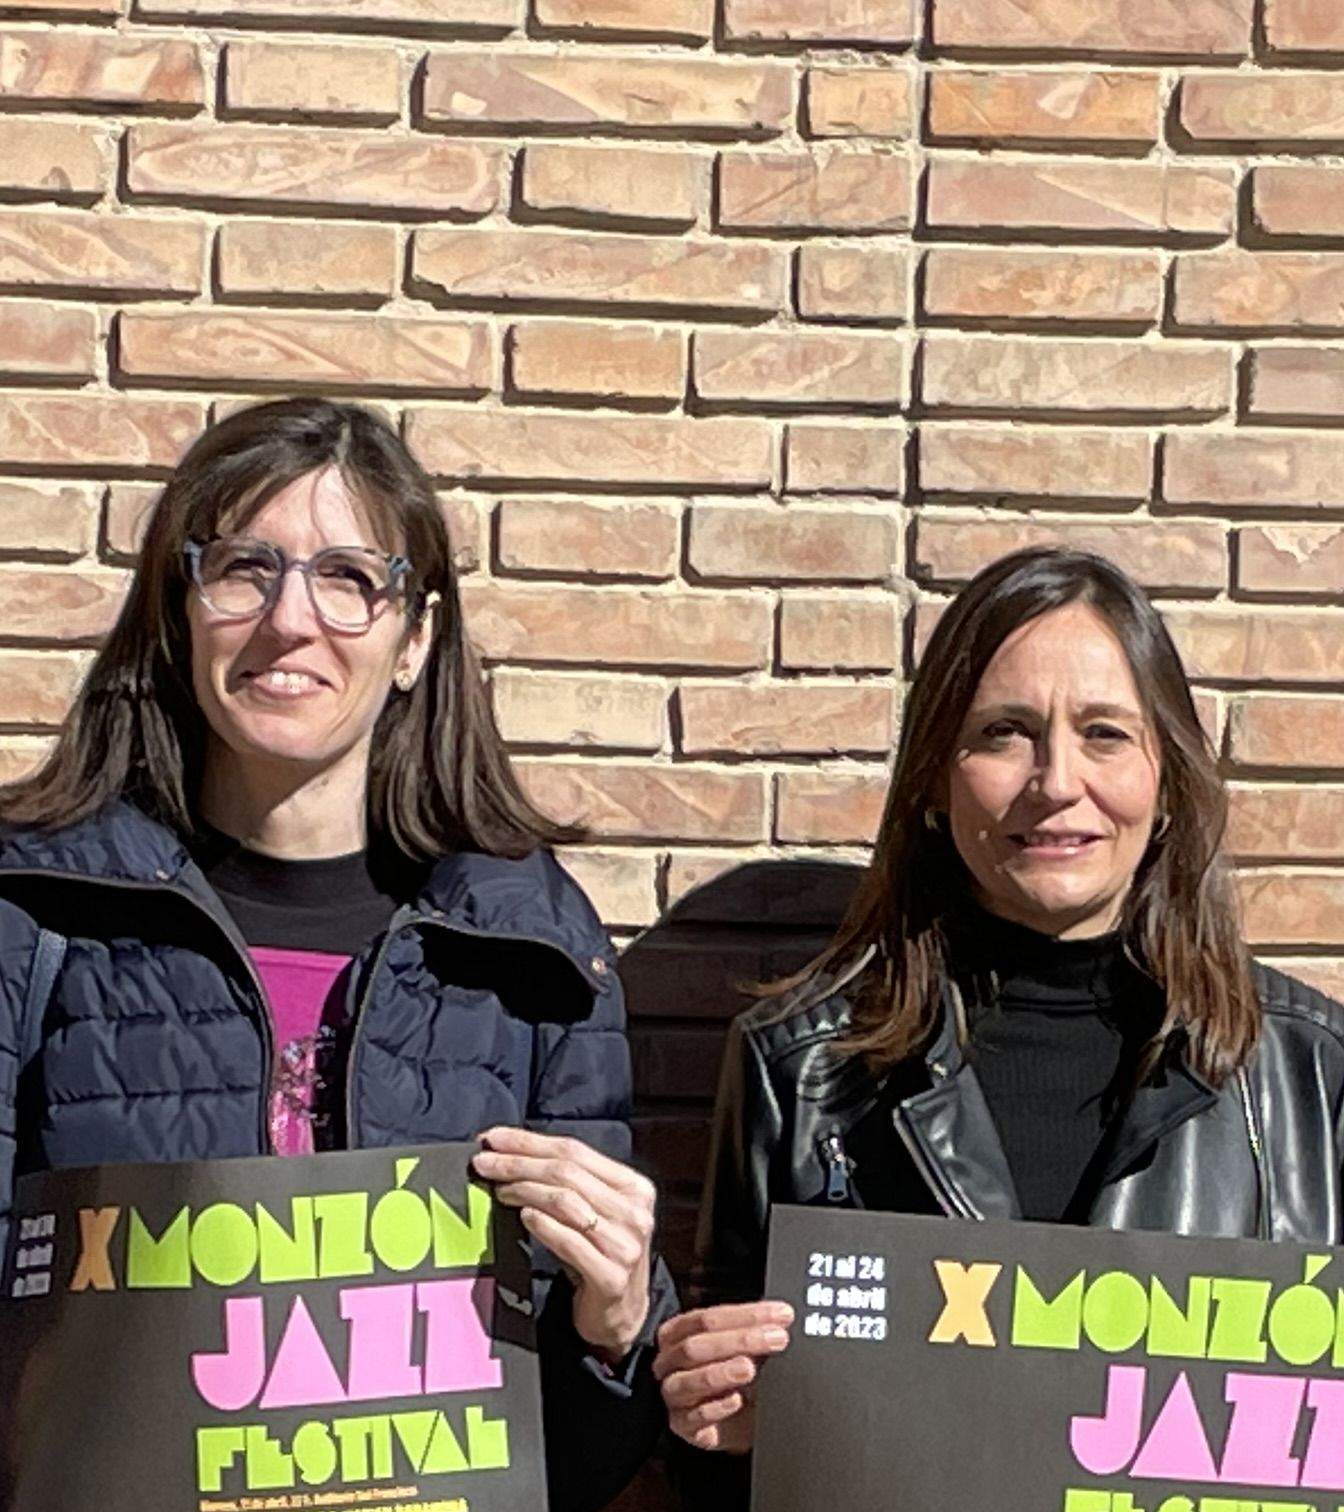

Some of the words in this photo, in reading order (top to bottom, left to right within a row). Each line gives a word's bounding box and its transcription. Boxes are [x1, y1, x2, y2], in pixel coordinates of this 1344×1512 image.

[70, 1206, 120, 1291] X
[128, 1158, 493, 1287] MONZÓN
[809, 1253, 834, 1277] 21
[835, 1255, 856, 1279] al
[859, 1255, 885, 1281] 24
[805, 1312, 832, 1336] de
[834, 1314, 887, 1341] 2023
[807, 1282, 834, 1306] de
[837, 1285, 887, 1311] abril
[928, 1259, 1003, 1347] X
[191, 1278, 504, 1408] JAZZ
[197, 1406, 510, 1492] FESTIVAL
